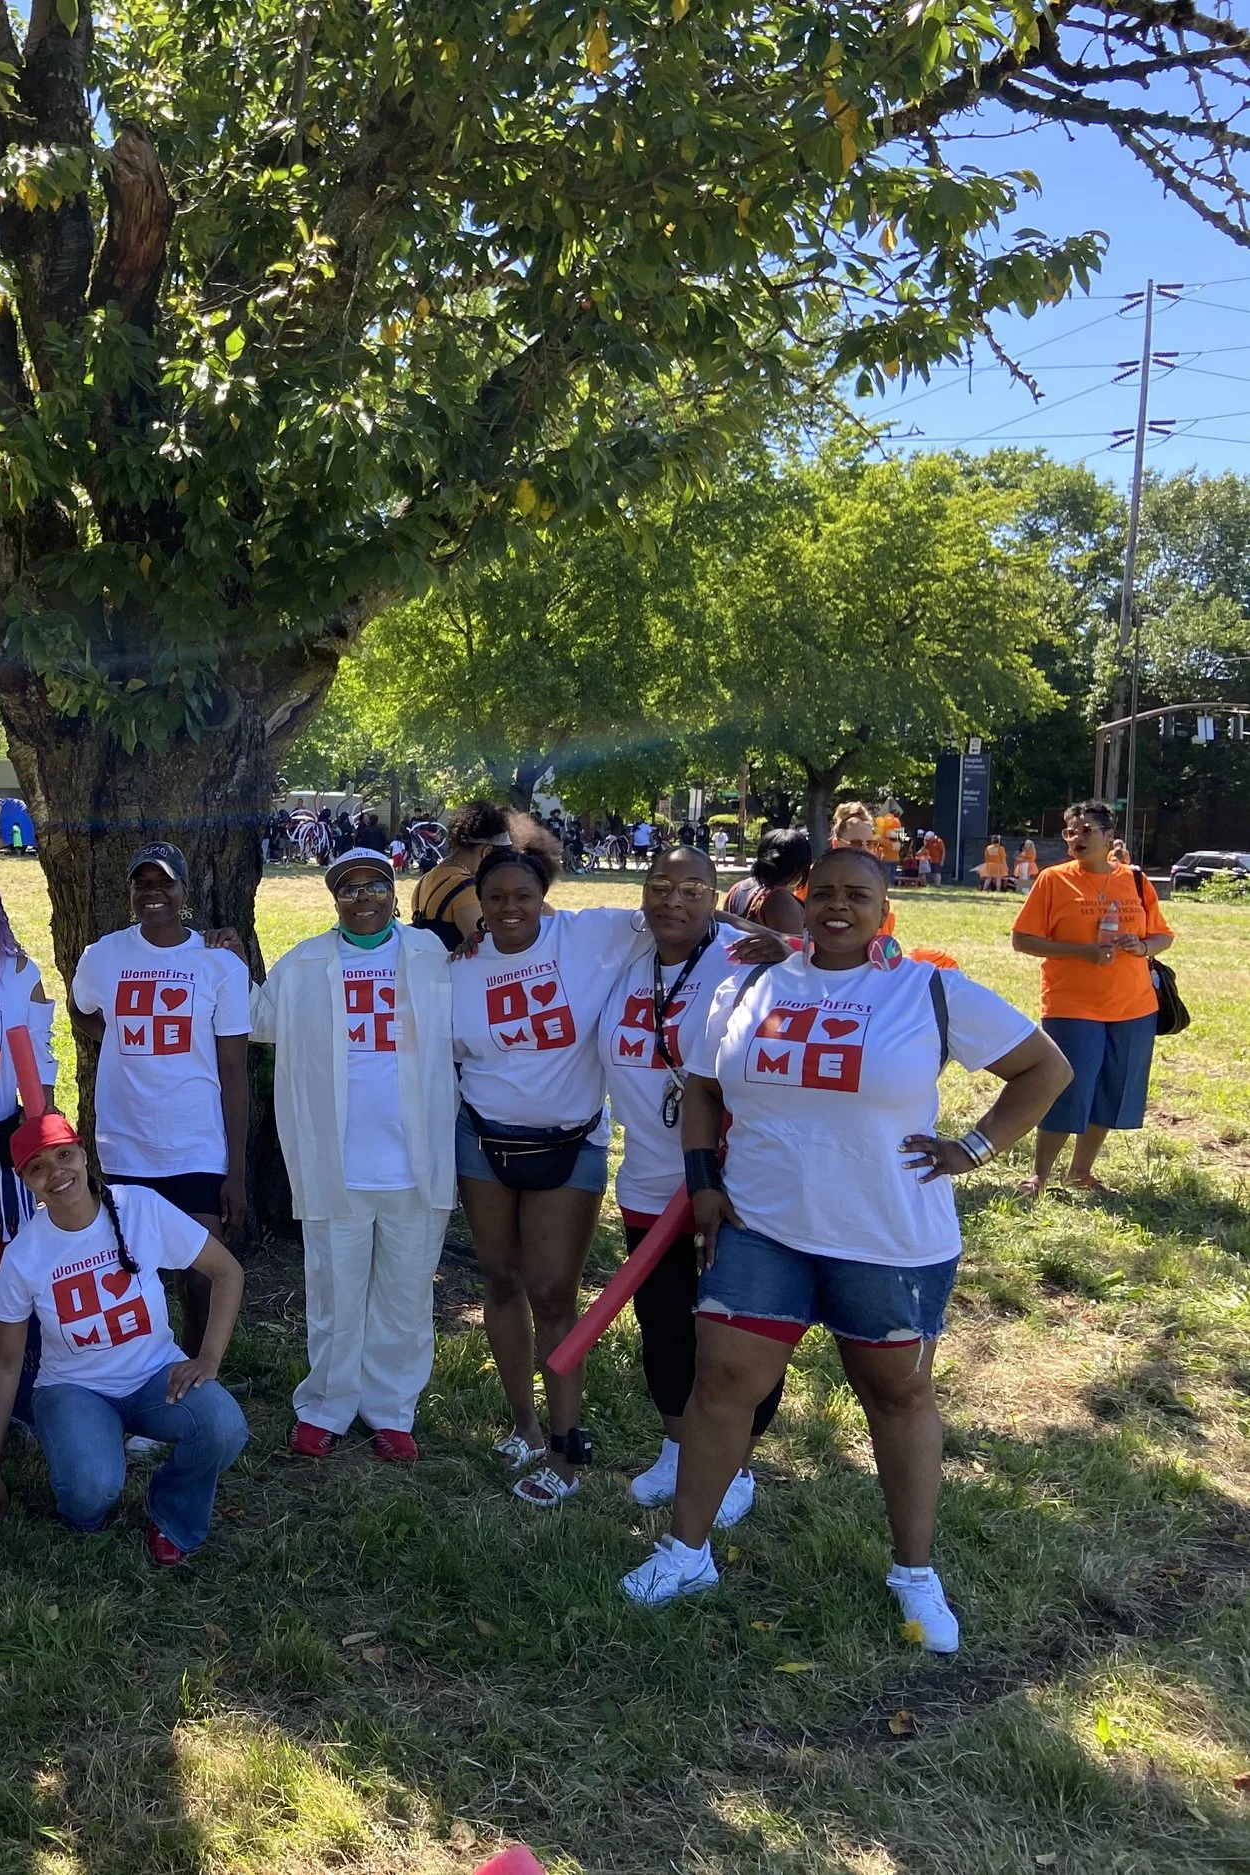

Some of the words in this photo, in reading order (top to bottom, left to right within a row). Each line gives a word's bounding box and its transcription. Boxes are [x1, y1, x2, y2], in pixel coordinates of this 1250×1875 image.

[121, 969, 195, 981] WomenFirst
[485, 959, 558, 988] WomenFirst
[52, 1242, 132, 1281] WomenFirt
